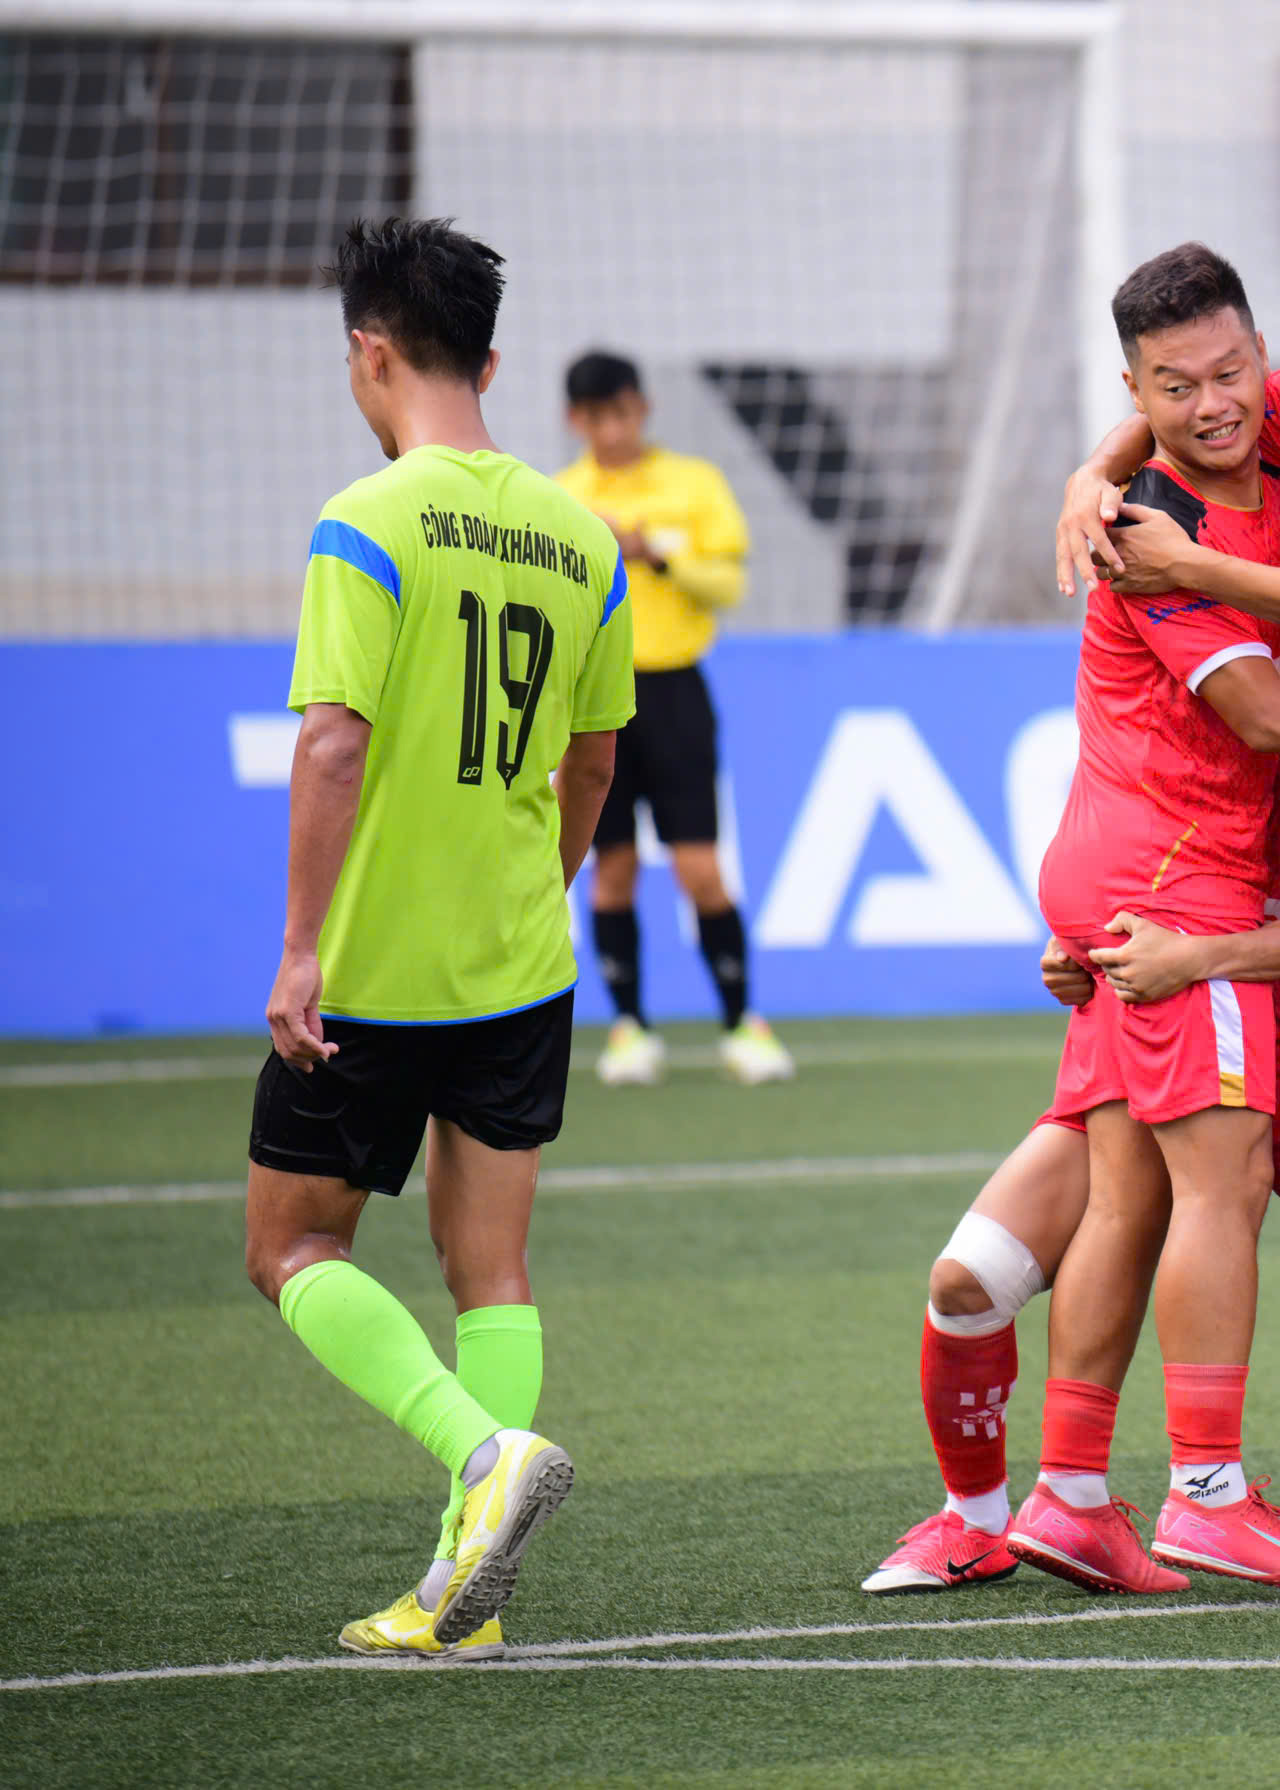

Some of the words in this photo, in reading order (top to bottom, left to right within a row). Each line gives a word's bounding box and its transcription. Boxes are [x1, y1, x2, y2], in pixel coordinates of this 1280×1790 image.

[420, 504, 461, 549] CÔNG
[499, 522, 558, 572] KHÁNH
[458, 589, 554, 791] 19
